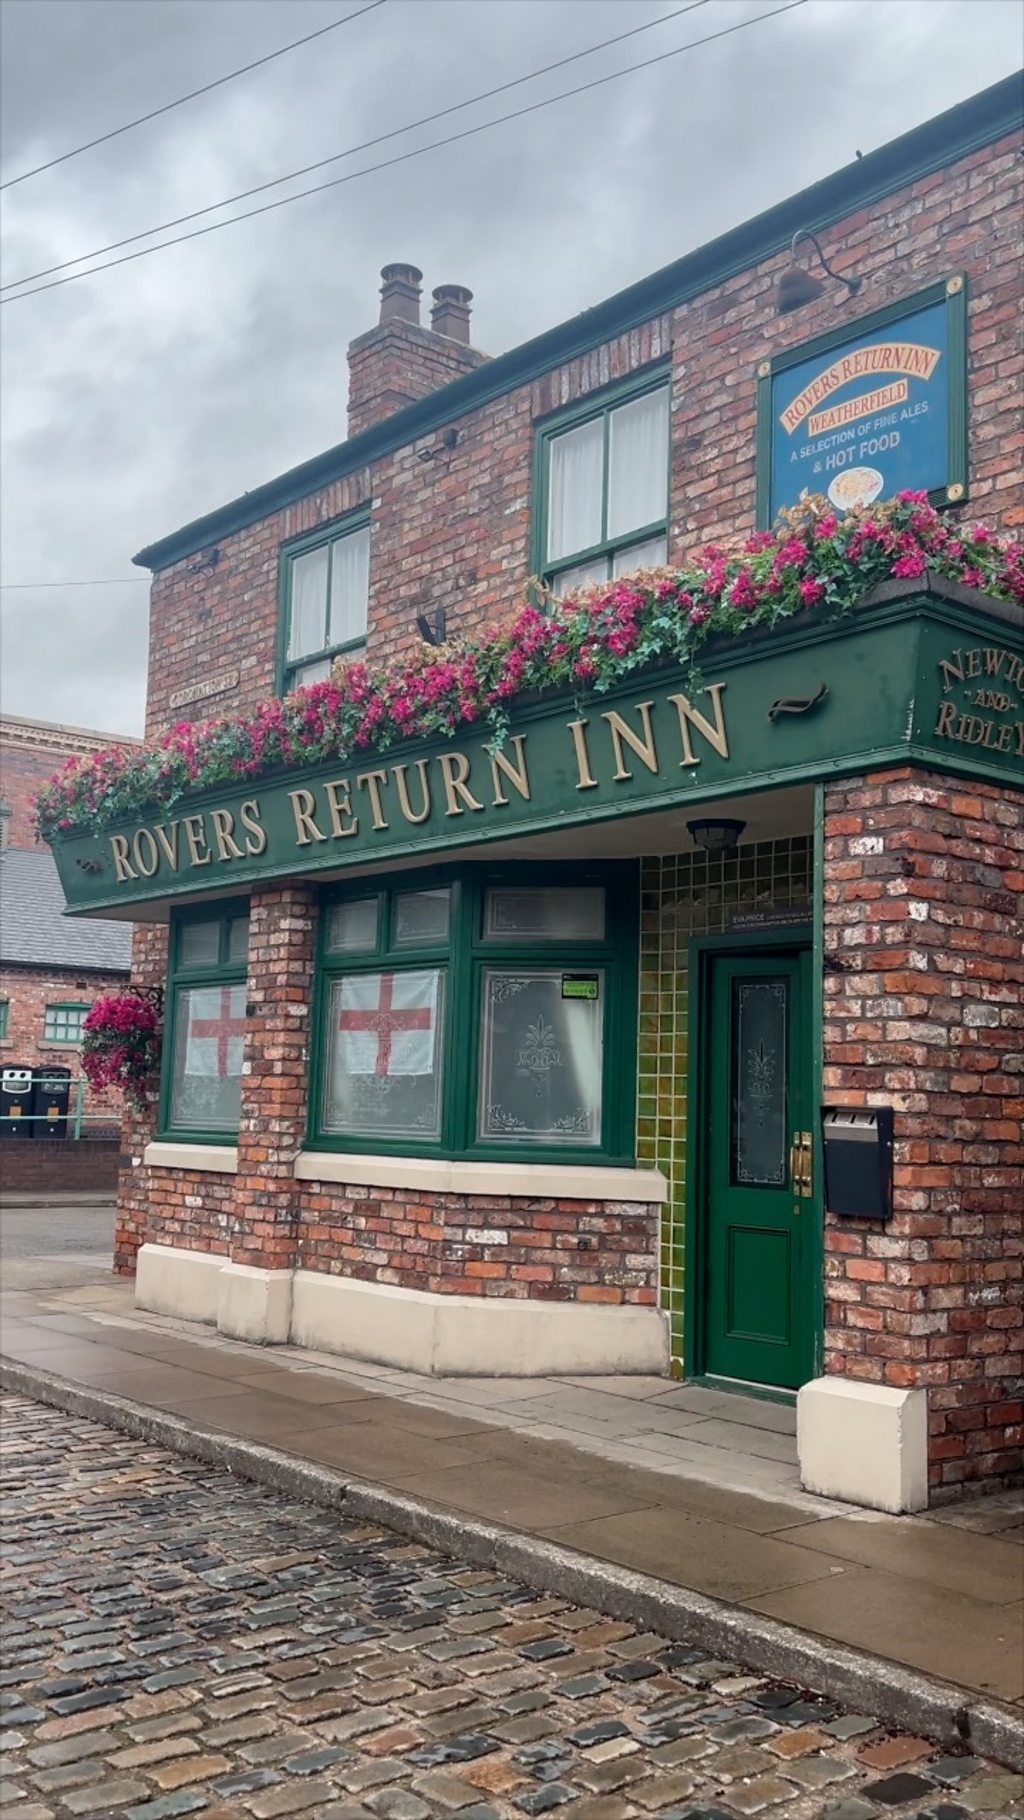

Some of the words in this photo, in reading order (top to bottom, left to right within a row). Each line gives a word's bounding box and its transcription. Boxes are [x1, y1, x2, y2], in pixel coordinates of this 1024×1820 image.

[784, 367, 840, 427] ROVERS
[842, 348, 904, 379] RETURN
[903, 349, 936, 376] INN
[810, 382, 907, 433] WEATHERFIELD
[790, 450, 798, 462] A
[800, 429, 855, 459] SELECTION
[857, 422, 872, 437] OF
[874, 412, 898, 431] FINE
[900, 401, 929, 421] ALES
[813, 461, 822, 473] &
[825, 445, 857, 471] HOT
[859, 430, 901, 460] FOOD
[109, 799, 268, 883] ROVERS
[287, 734, 532, 846] RETURN
[566, 682, 731, 790] INN
